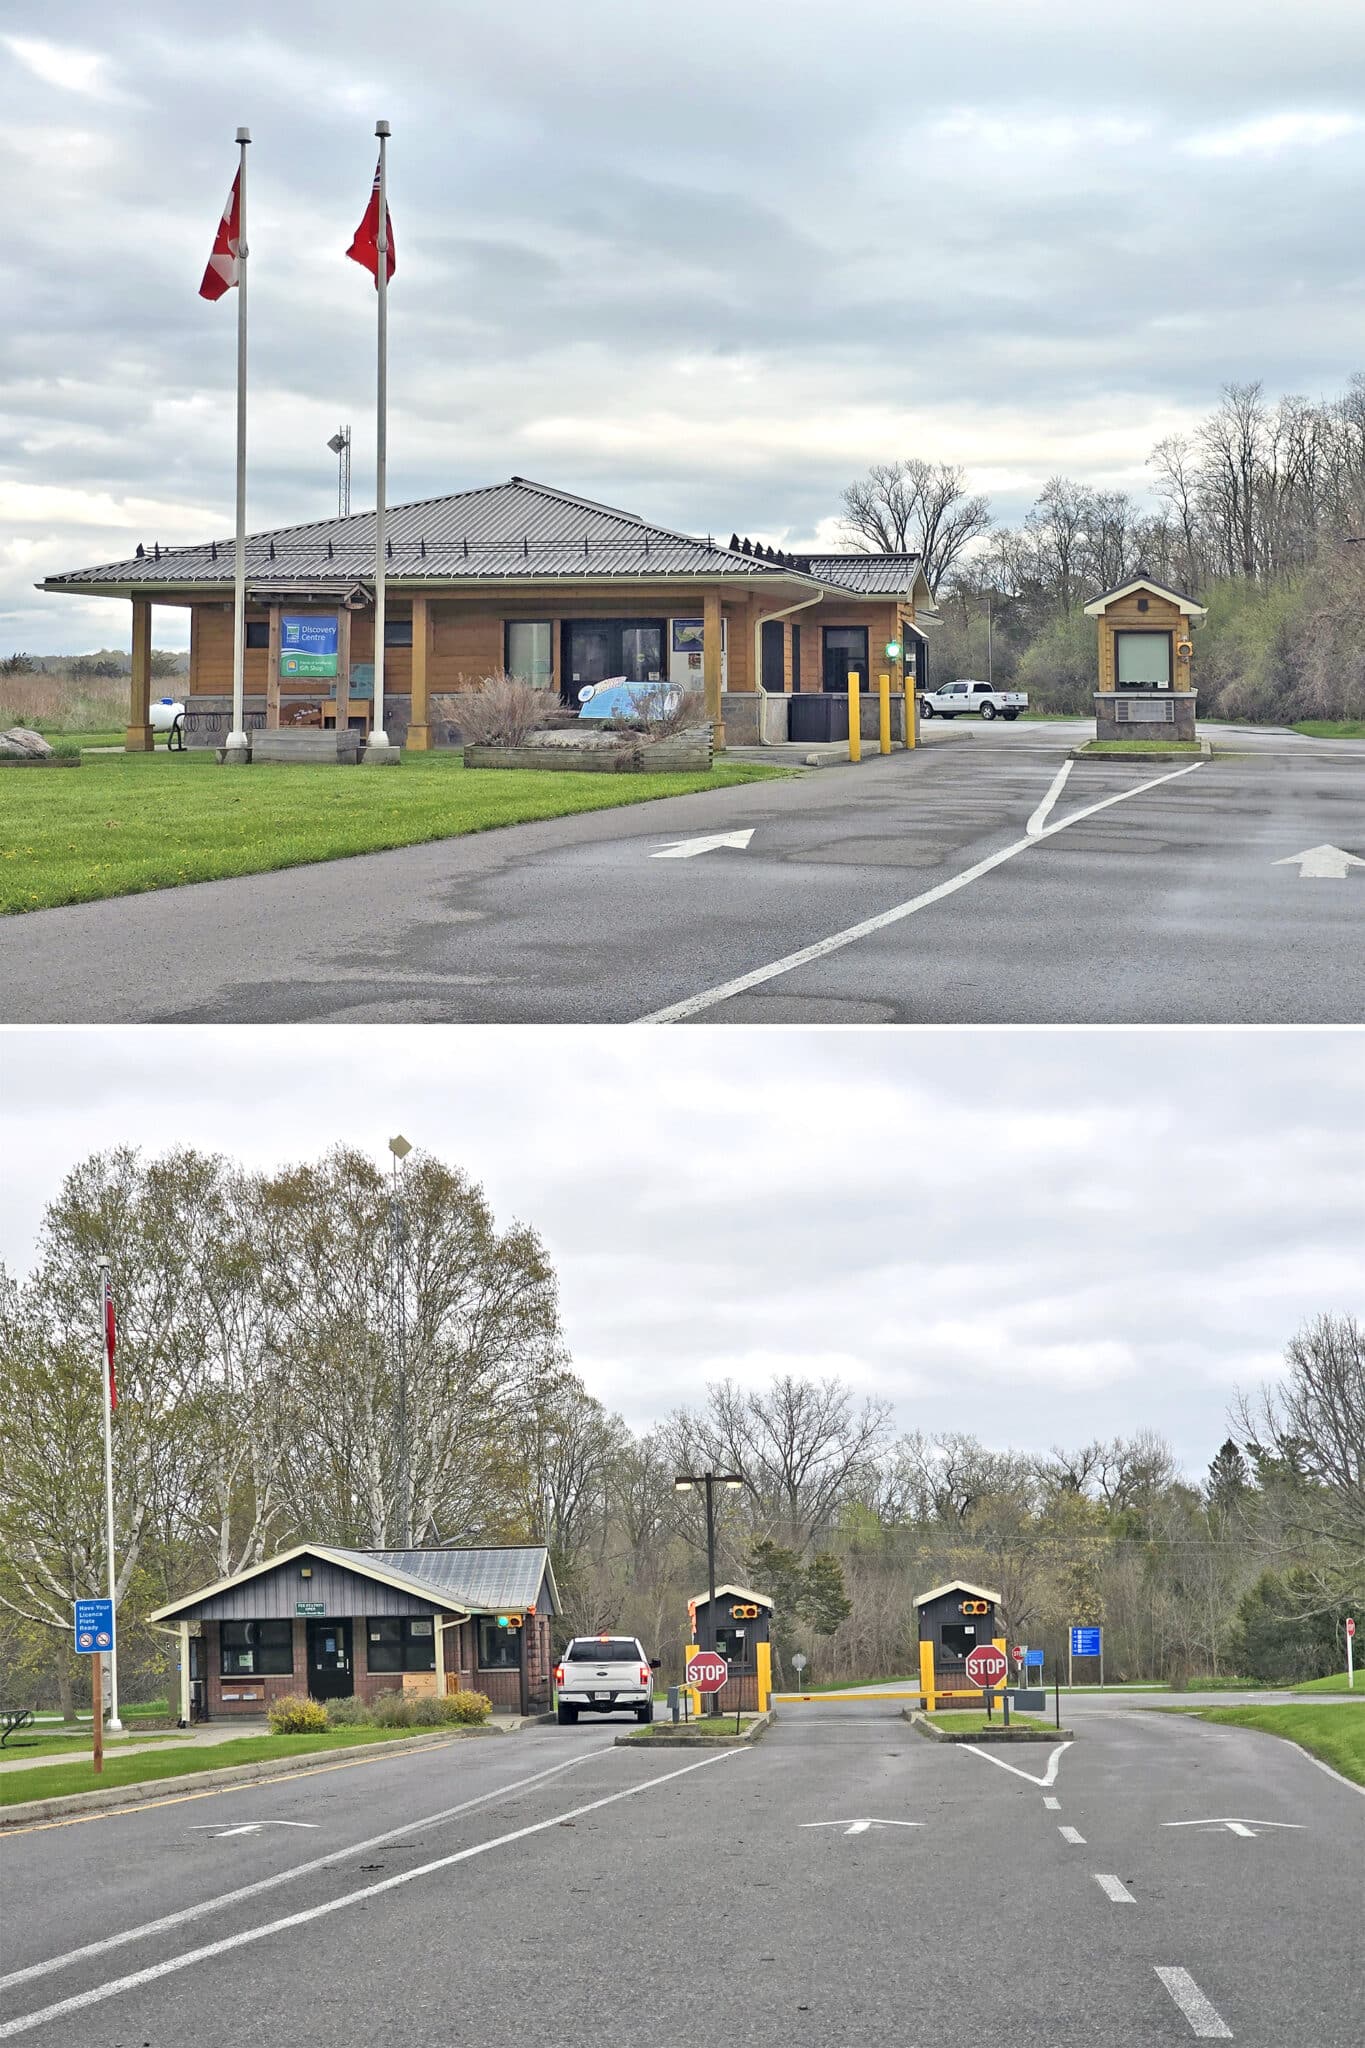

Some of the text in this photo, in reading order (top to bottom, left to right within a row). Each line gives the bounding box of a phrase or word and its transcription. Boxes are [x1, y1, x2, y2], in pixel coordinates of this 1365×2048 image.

[302, 625, 336, 635] Discovery
[688, 1665, 725, 1681] STOP
[969, 1658, 1005, 1675] STOP
